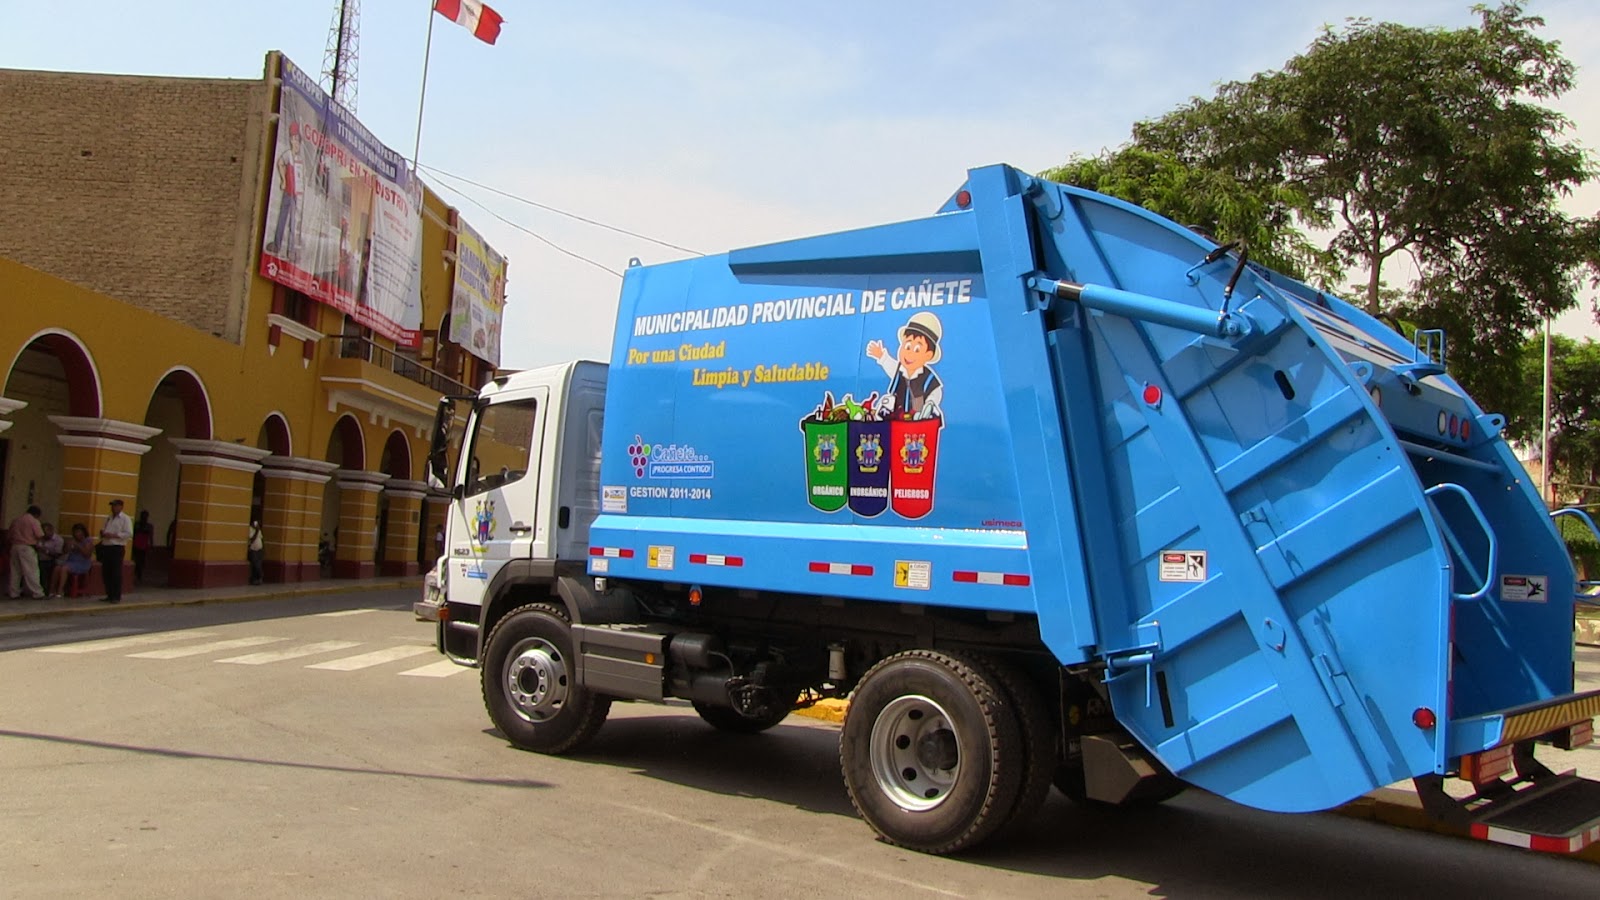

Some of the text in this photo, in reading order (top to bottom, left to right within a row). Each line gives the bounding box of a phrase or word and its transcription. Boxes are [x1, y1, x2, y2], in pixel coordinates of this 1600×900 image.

[633, 278, 972, 337] MUNICIPALIDAD PROVINCIAL DE CAÑETE
[628, 341, 726, 365] Por una Ciudad
[692, 361, 830, 389] Limpia y Saludable
[629, 486, 668, 498] GESTION
[669, 487, 712, 500] 2011-2014
[812, 485, 844, 496] ORGÁNICO
[850, 486, 887, 498] INORGÁNICO
[894, 488, 930, 499] PELIGROSO
